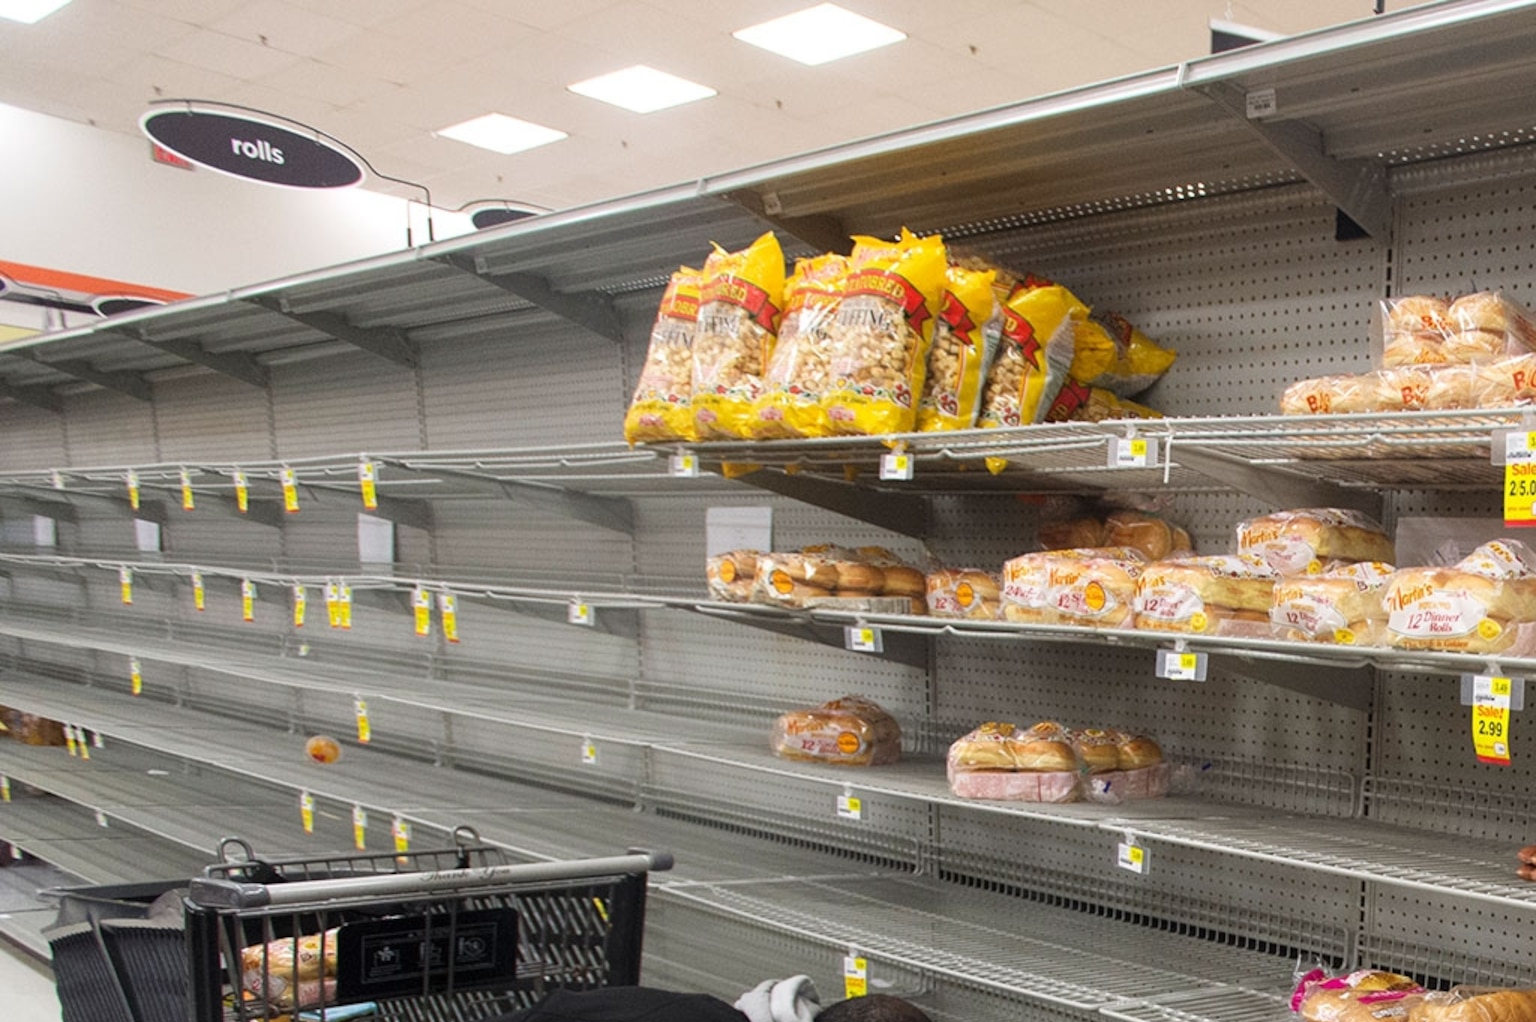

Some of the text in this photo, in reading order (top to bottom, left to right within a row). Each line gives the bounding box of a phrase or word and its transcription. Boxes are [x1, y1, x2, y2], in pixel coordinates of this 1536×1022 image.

[230, 138, 285, 165] rolls
[1387, 584, 1433, 611] Martin's
[1143, 600, 1159, 612] 12
[1407, 614, 1423, 630] 12
[1423, 611, 1463, 622] Dinner
[1429, 622, 1453, 633] Rolls
[1477, 705, 1504, 719] Sale!
[1478, 720, 1503, 738] 2.99
